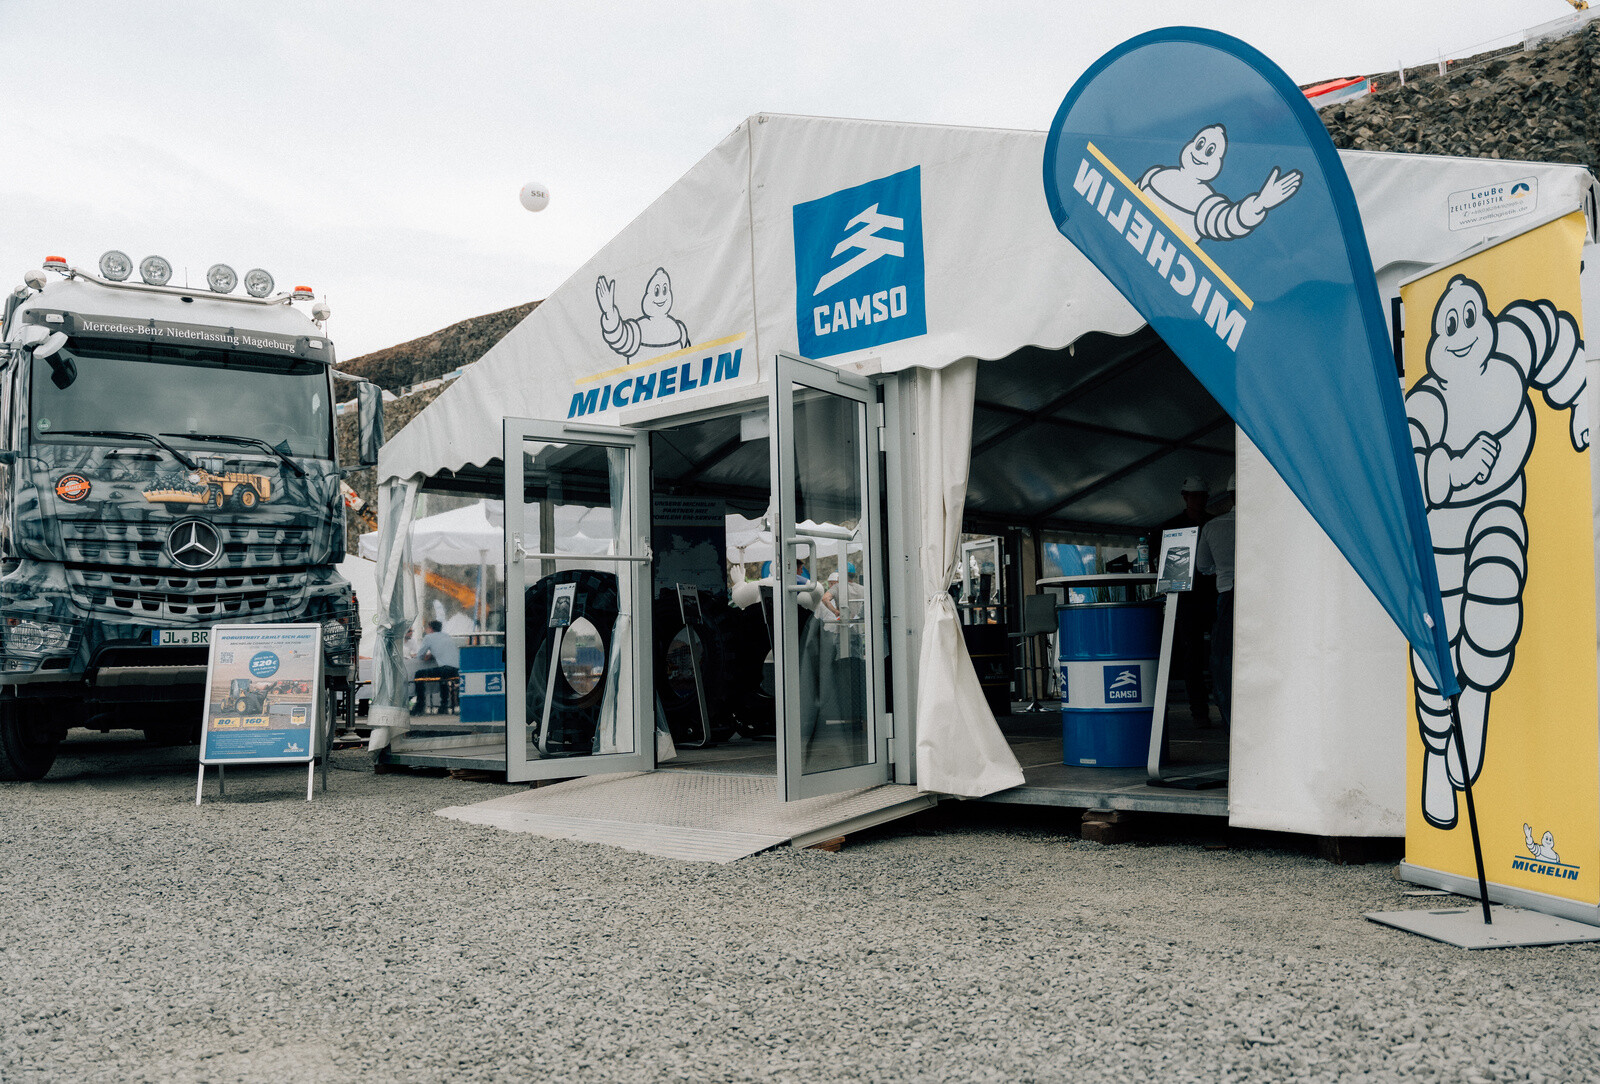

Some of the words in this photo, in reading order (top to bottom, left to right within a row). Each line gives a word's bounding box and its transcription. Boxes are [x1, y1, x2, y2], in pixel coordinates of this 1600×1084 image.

[1471, 187, 1504, 200] LeuBe
[1450, 196, 1504, 213] ZELTLOGISTIK
[813, 285, 908, 336] CAMSO
[83, 320, 164, 336] Mercedes-Benz
[166, 327, 240, 346] Niederlassung
[242, 337, 296, 354] Magdeburg
[567, 348, 744, 419] MICHELIN
[163, 631, 180, 643] JL
[192, 631, 208, 643] BR
[1109, 690, 1138, 699] CAMSO
[1512, 860, 1579, 880] MICHELIN
